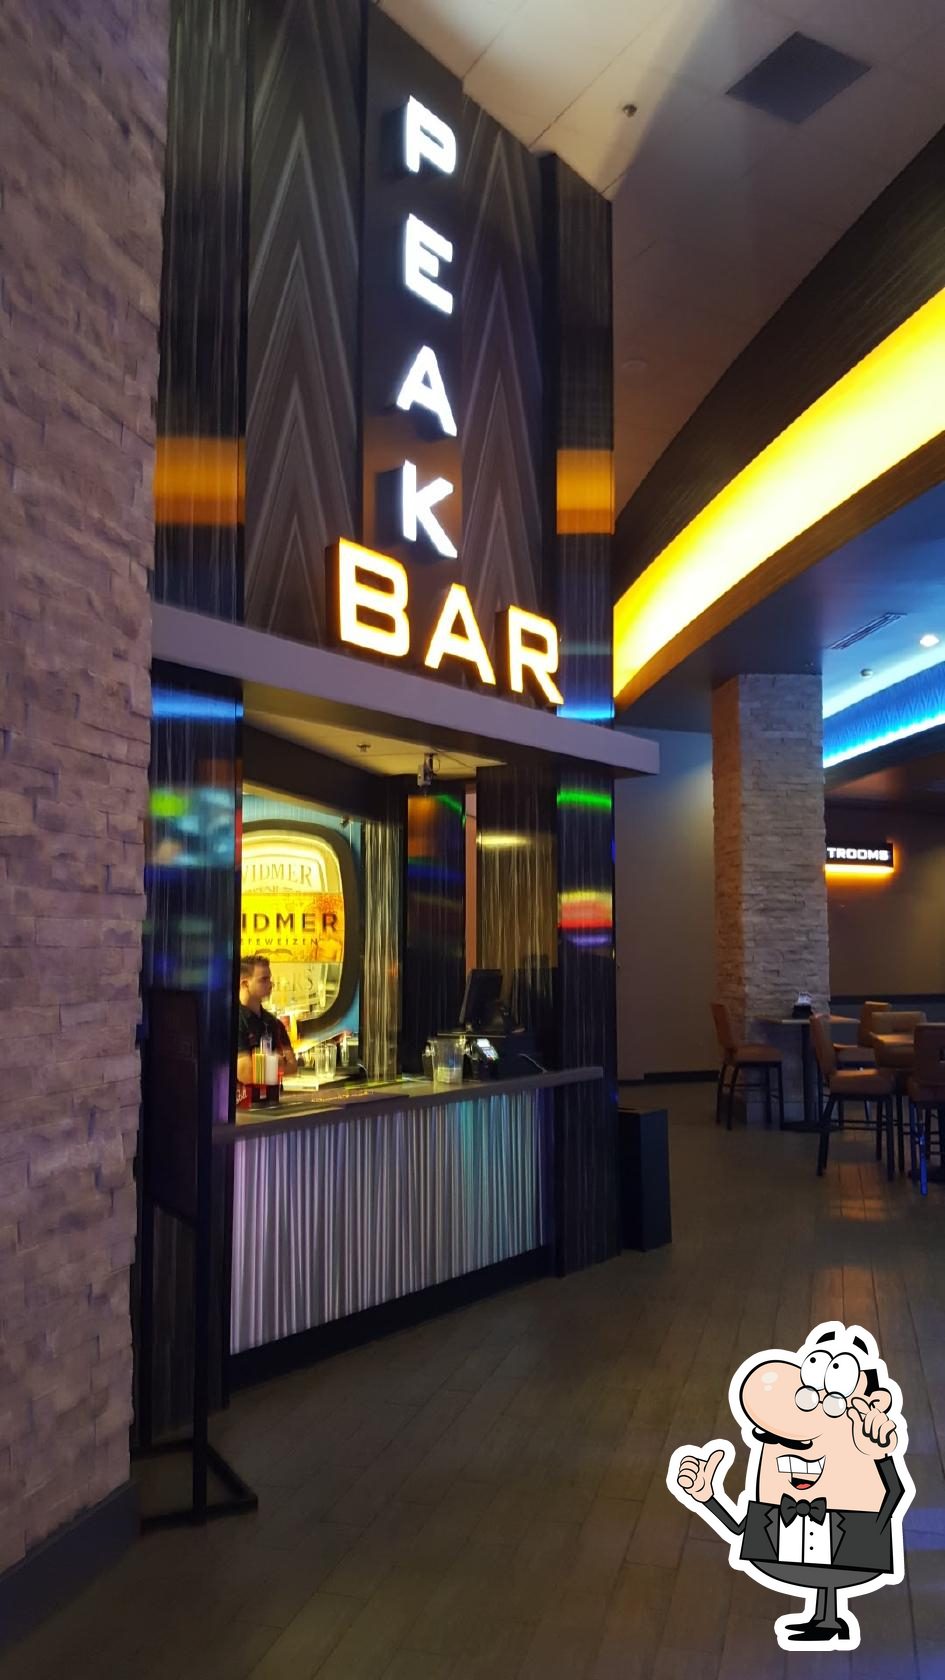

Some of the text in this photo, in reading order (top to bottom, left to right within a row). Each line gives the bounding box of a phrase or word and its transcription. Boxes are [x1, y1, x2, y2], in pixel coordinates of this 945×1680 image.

[396, 95, 458, 560] PEAK
[338, 536, 564, 705] BAR
[826, 847, 889, 861] TROOMS
